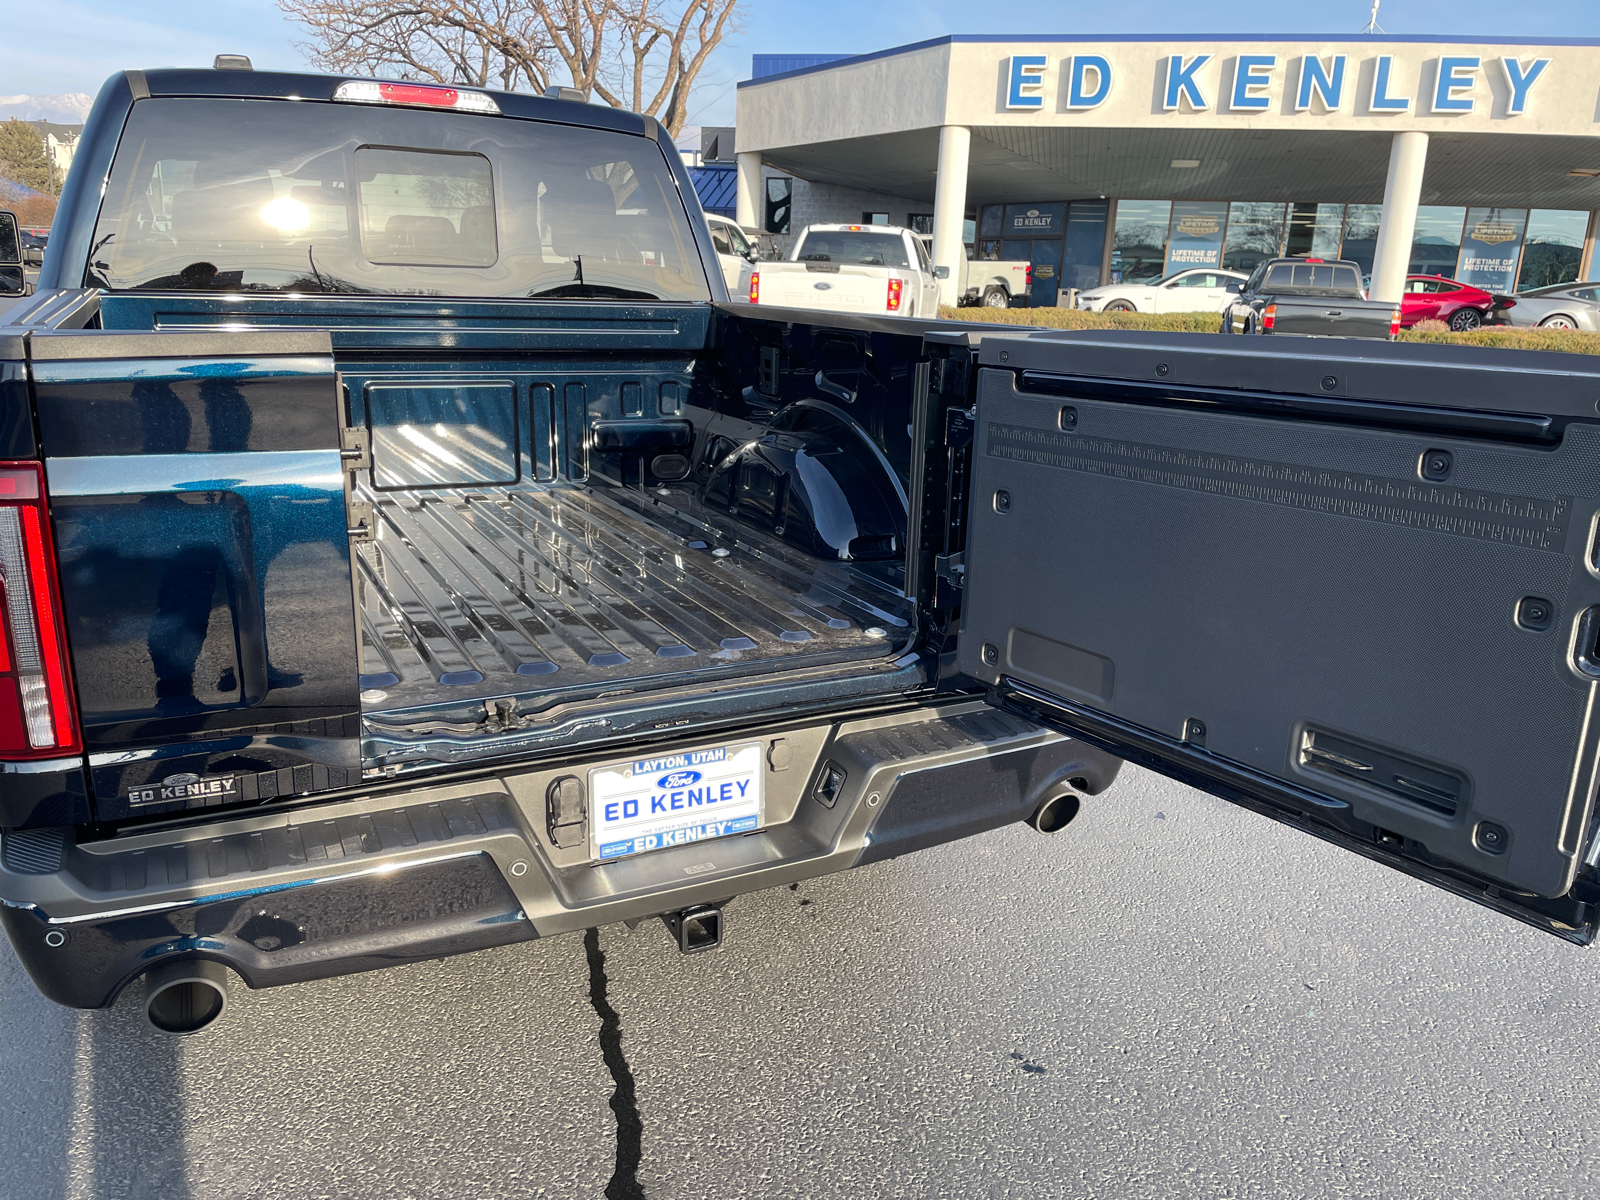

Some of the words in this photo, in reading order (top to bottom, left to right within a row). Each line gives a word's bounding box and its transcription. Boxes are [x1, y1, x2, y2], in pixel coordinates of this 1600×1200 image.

[1006, 54, 1113, 110] ED
[1163, 53, 1554, 115] KENLEY
[1014, 218, 1023, 226] ED
[1025, 217, 1051, 226] KENLEY
[1172, 249, 1205, 257] LIFETIME
[1465, 257, 1500, 265] LIFETIME
[1463, 264, 1513, 272] PROTECTION
[635, 755, 688, 774] LAYTON,
[692, 749, 724, 764] UTAH
[665, 773, 694, 788] Ford
[129, 790, 154, 803] ED
[161, 779, 234, 799] KENLEY
[605, 799, 638, 822] ED
[651, 779, 750, 813] KENLEY
[634, 836, 657, 852] ED
[662, 821, 727, 846] KENLEY
